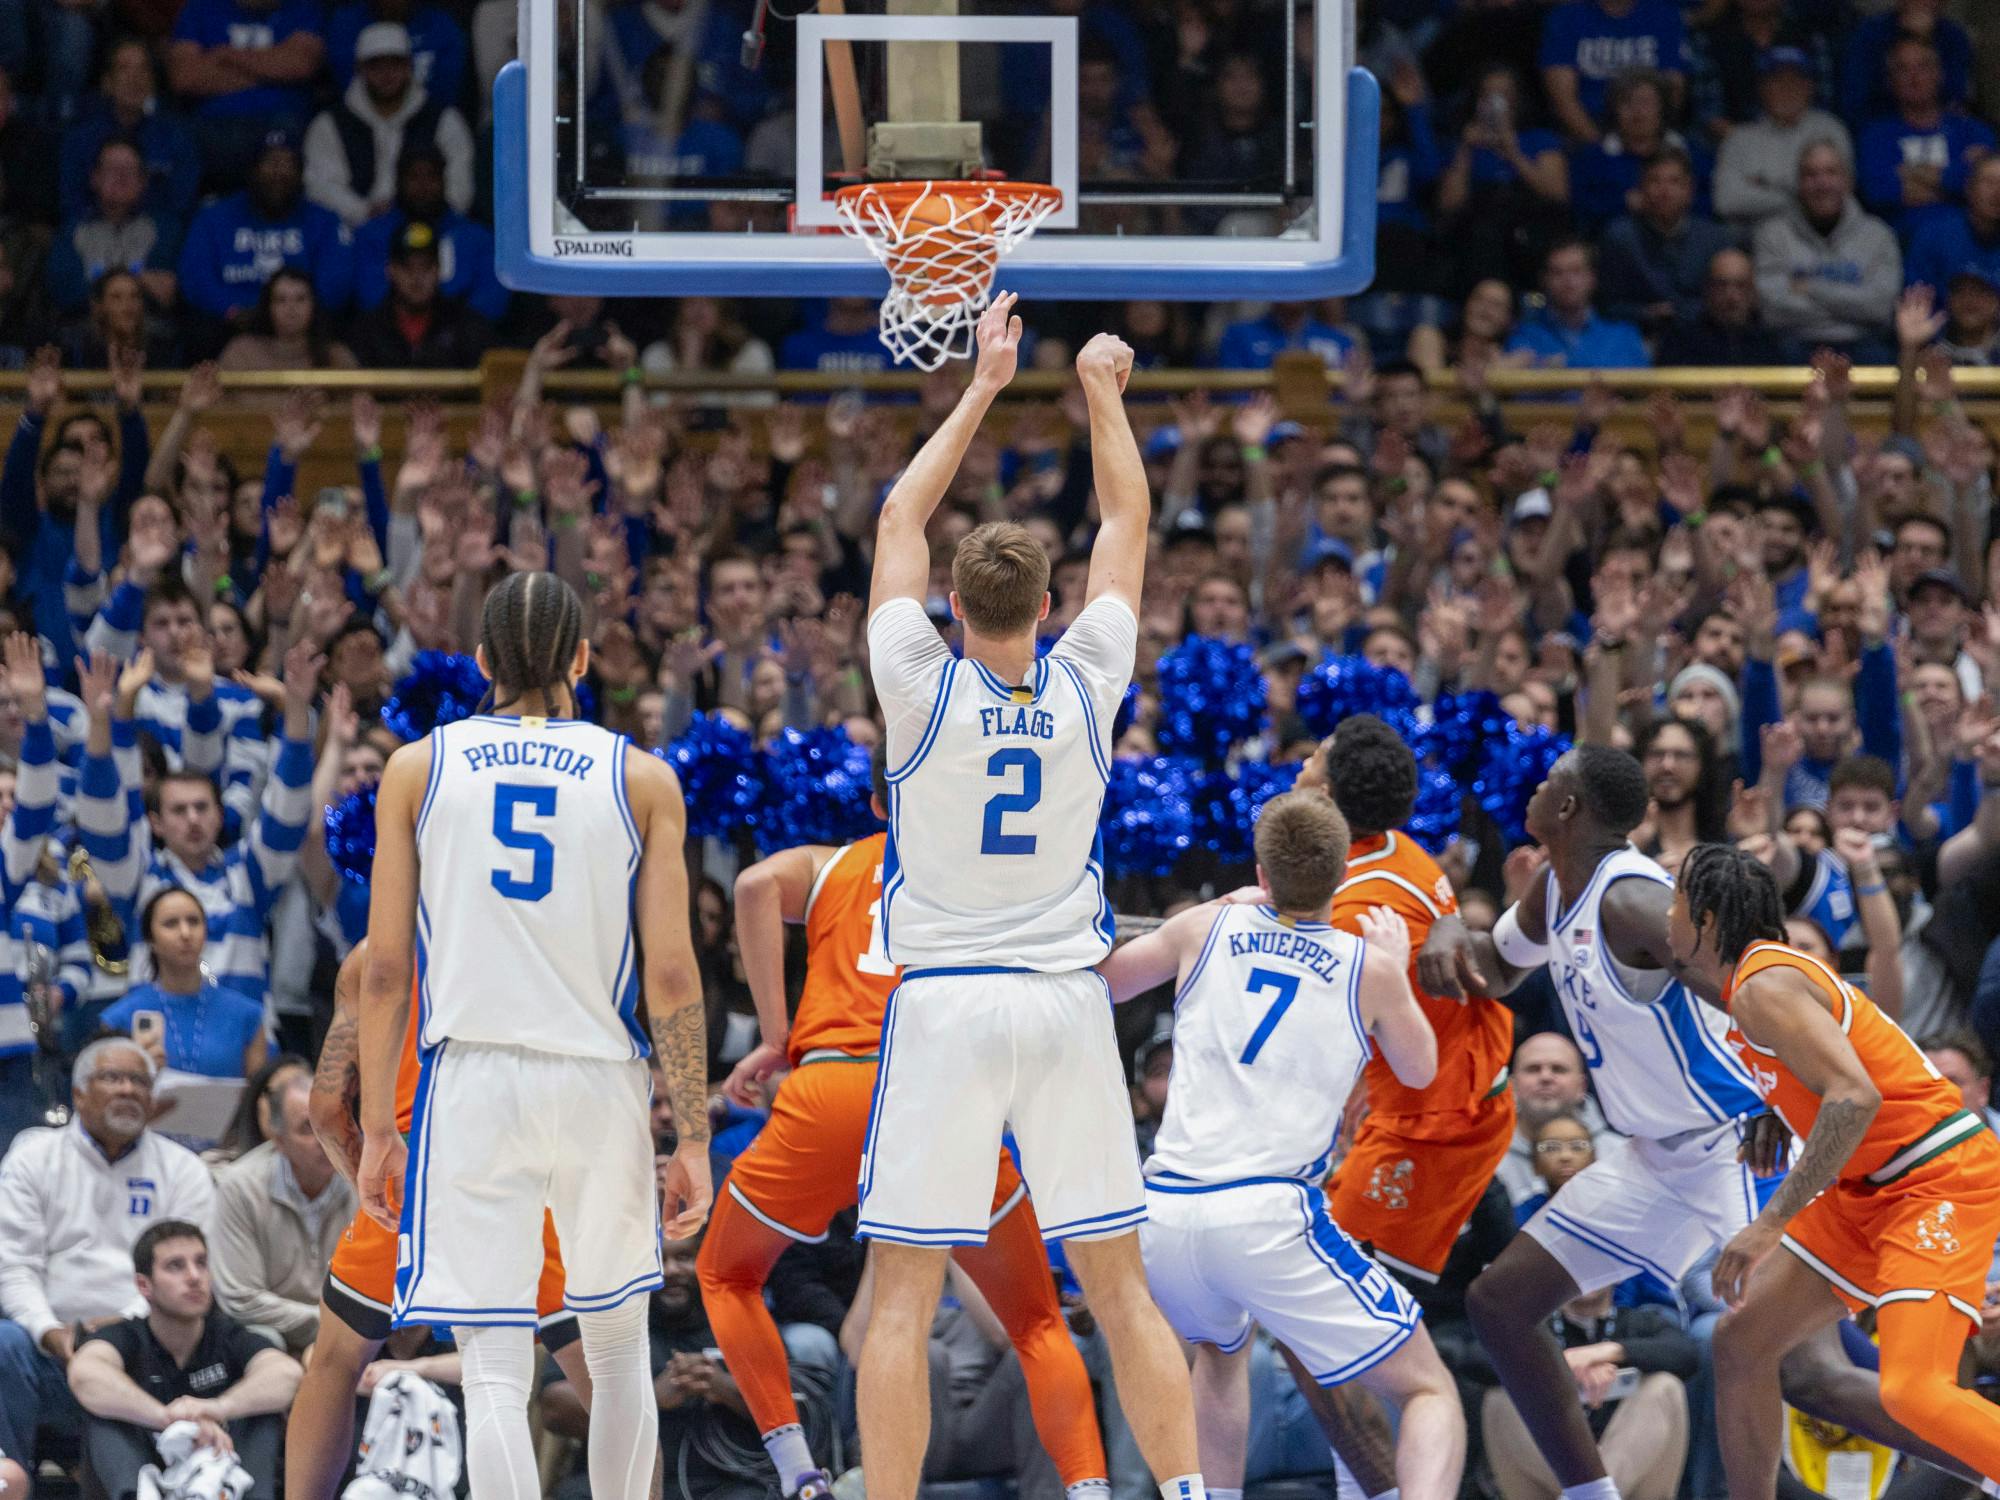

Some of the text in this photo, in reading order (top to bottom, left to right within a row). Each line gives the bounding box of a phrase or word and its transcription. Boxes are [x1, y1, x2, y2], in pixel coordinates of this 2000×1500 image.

[553, 239, 633, 257] SPALDING
[980, 706, 1054, 740] FLAGG
[462, 740, 595, 781] PROCTOR
[981, 747, 1042, 855] 2
[491, 782, 558, 902] 5
[1228, 931, 1342, 984] KNUEPPEL
[1238, 967, 1301, 1066] 7
